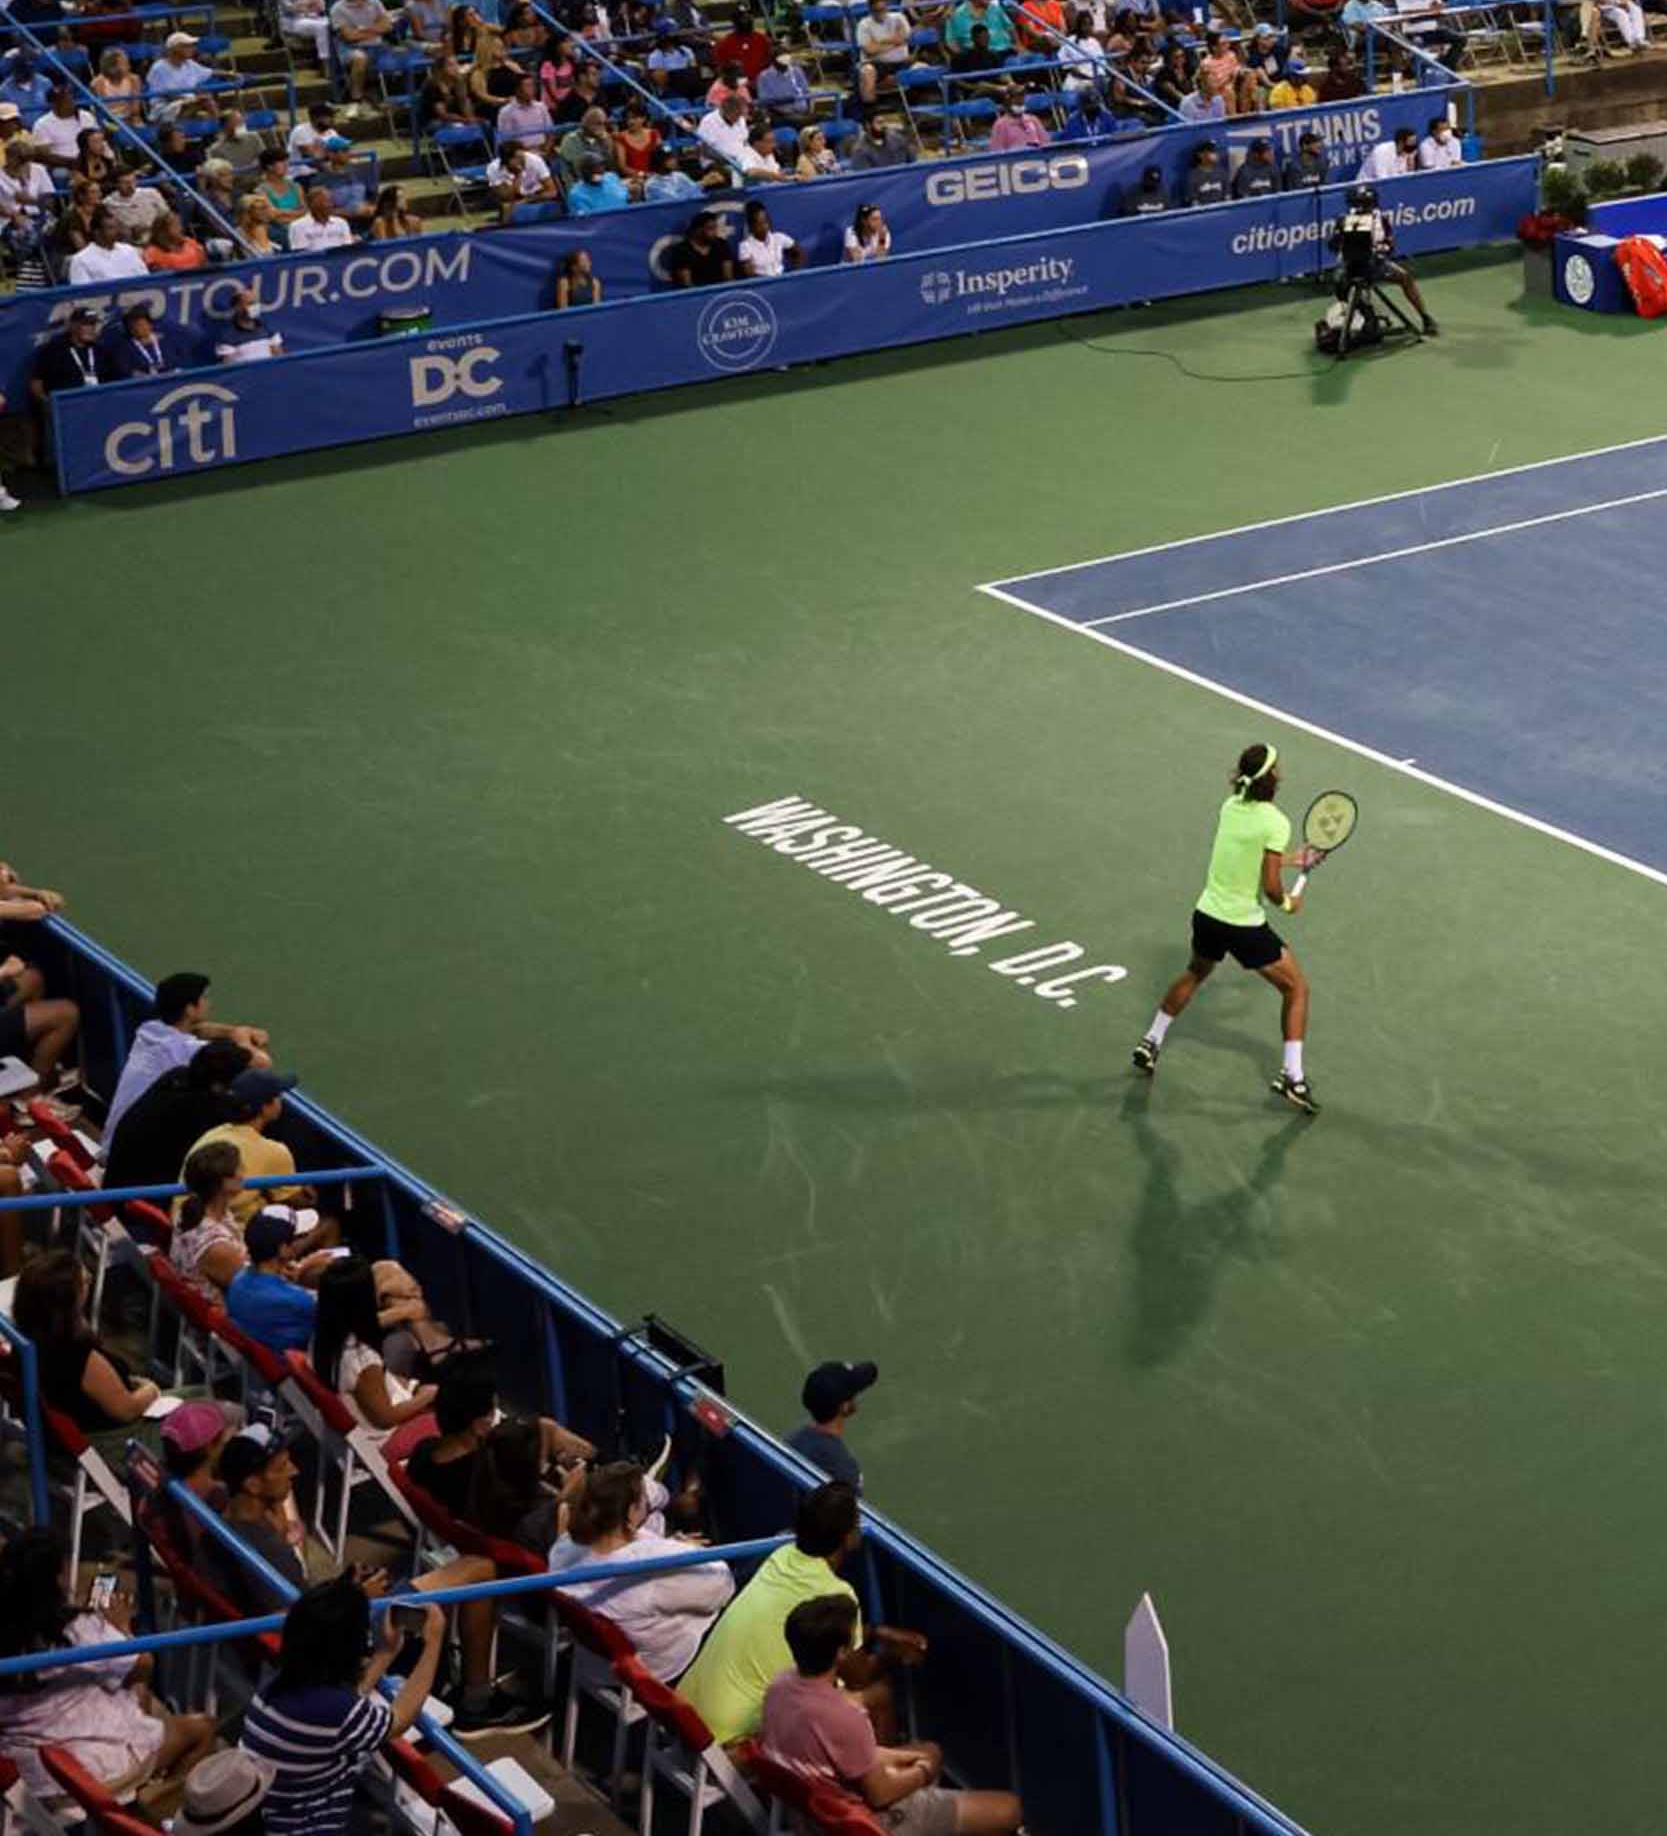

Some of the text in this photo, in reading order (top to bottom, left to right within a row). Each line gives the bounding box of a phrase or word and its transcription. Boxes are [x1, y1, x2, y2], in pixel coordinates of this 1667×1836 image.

[1276, 108, 1382, 155] TENNIS
[925, 154, 1090, 206] GEICO
[1232, 194, 1476, 254] citiopennis.com
[956, 255, 1074, 295] Insperity
[427, 332, 484, 353] events
[409, 345, 505, 407] DC
[104, 390, 239, 475] citi
[722, 795, 1128, 1008] WASHINGTON, D.C.
